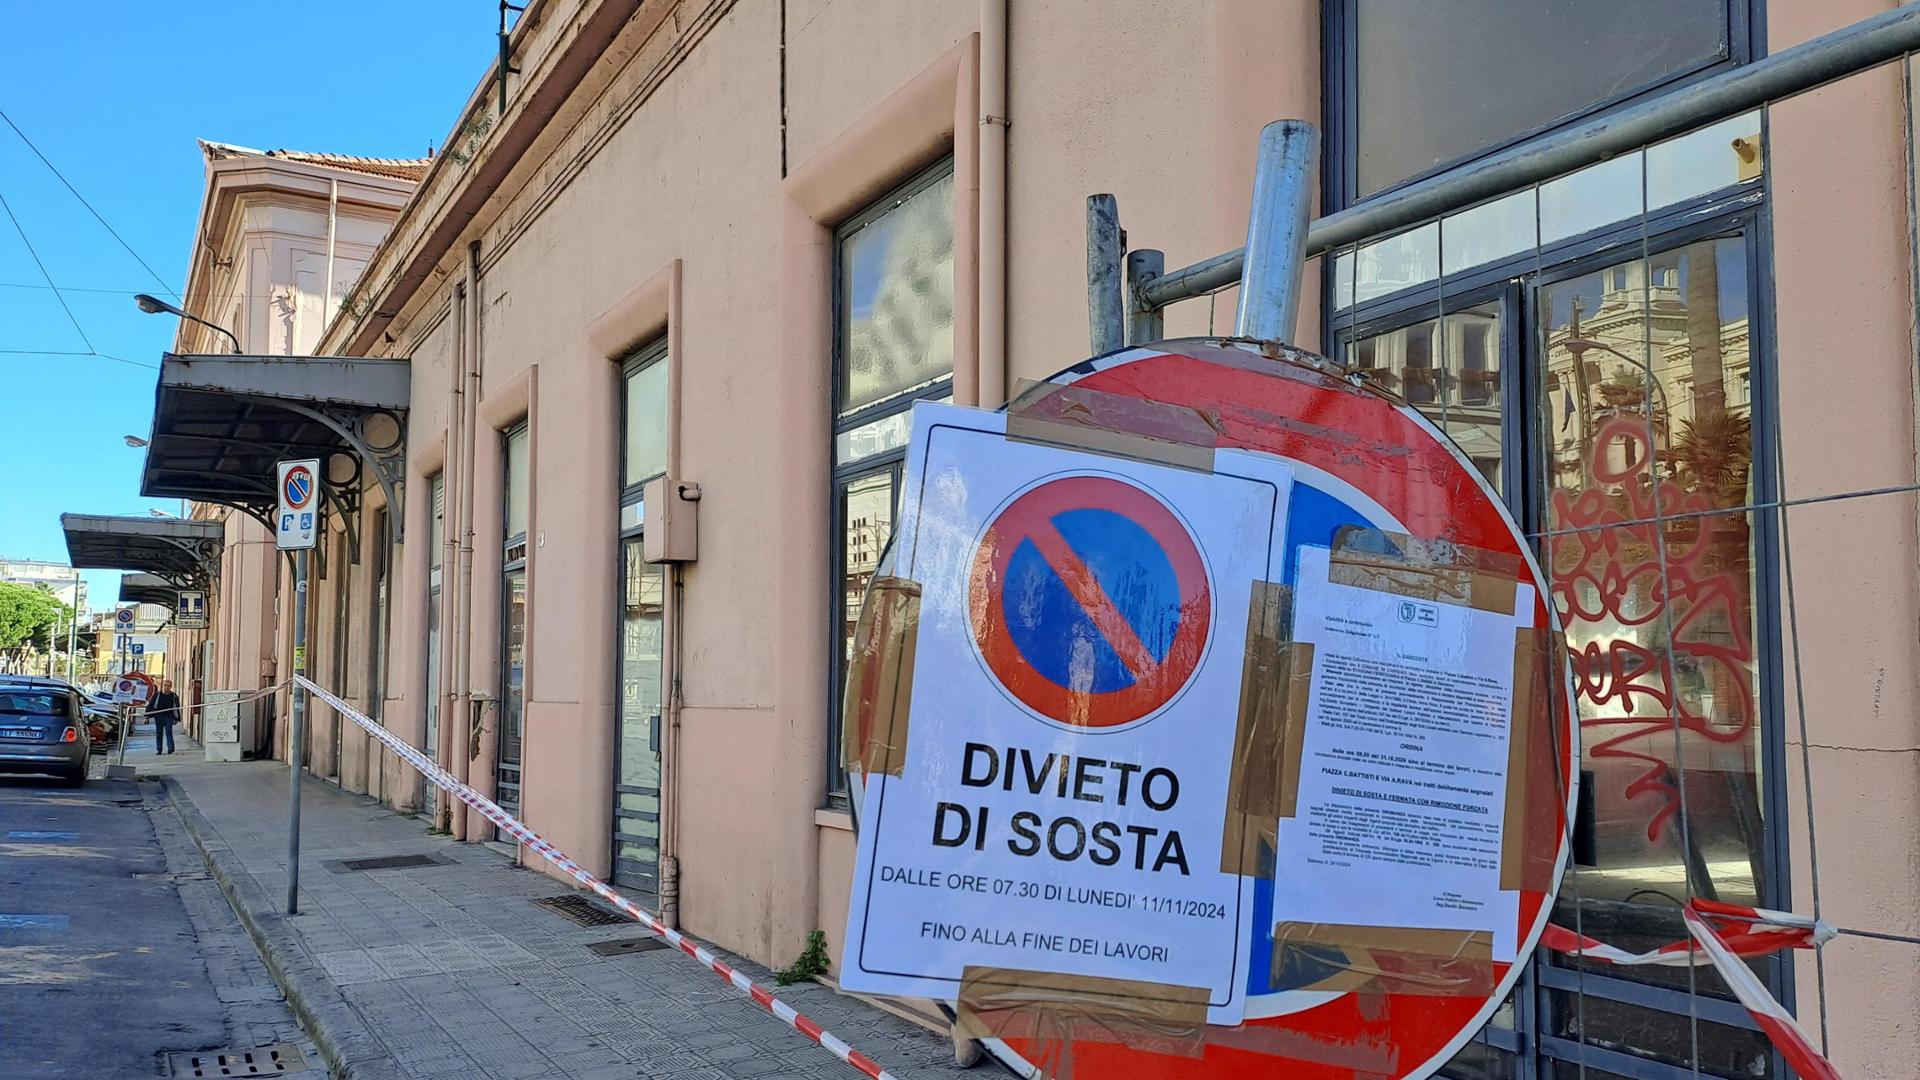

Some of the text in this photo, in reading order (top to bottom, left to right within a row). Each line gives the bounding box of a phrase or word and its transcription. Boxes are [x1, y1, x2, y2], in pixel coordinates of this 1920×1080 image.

[134, 645, 142, 654] P
[1400, 743, 1423, 752] ORDINA
[961, 742, 1180, 811] DIVIETO
[1321, 767, 1342, 775] PIAZZA
[1343, 769, 1374, 780] C.BATTISTI
[1391, 776, 1412, 785] A.RAVA
[1331, 786, 1354, 796] DIVIETO
[1363, 790, 1381, 799] SOSTA
[1388, 794, 1415, 804] FERMATA
[1416, 797, 1429, 805] CON
[1430, 799, 1461, 810] RIMOZIONE
[1462, 803, 1488, 813] FORZATA
[932, 802, 1191, 876] DI SOSTA
[881, 866, 1226, 920] DALLE ORE 07.30 DI LUNEDI' 11/11/2024
[921, 922, 1169, 963] FINO ALLA FINE DEI LAVORI
